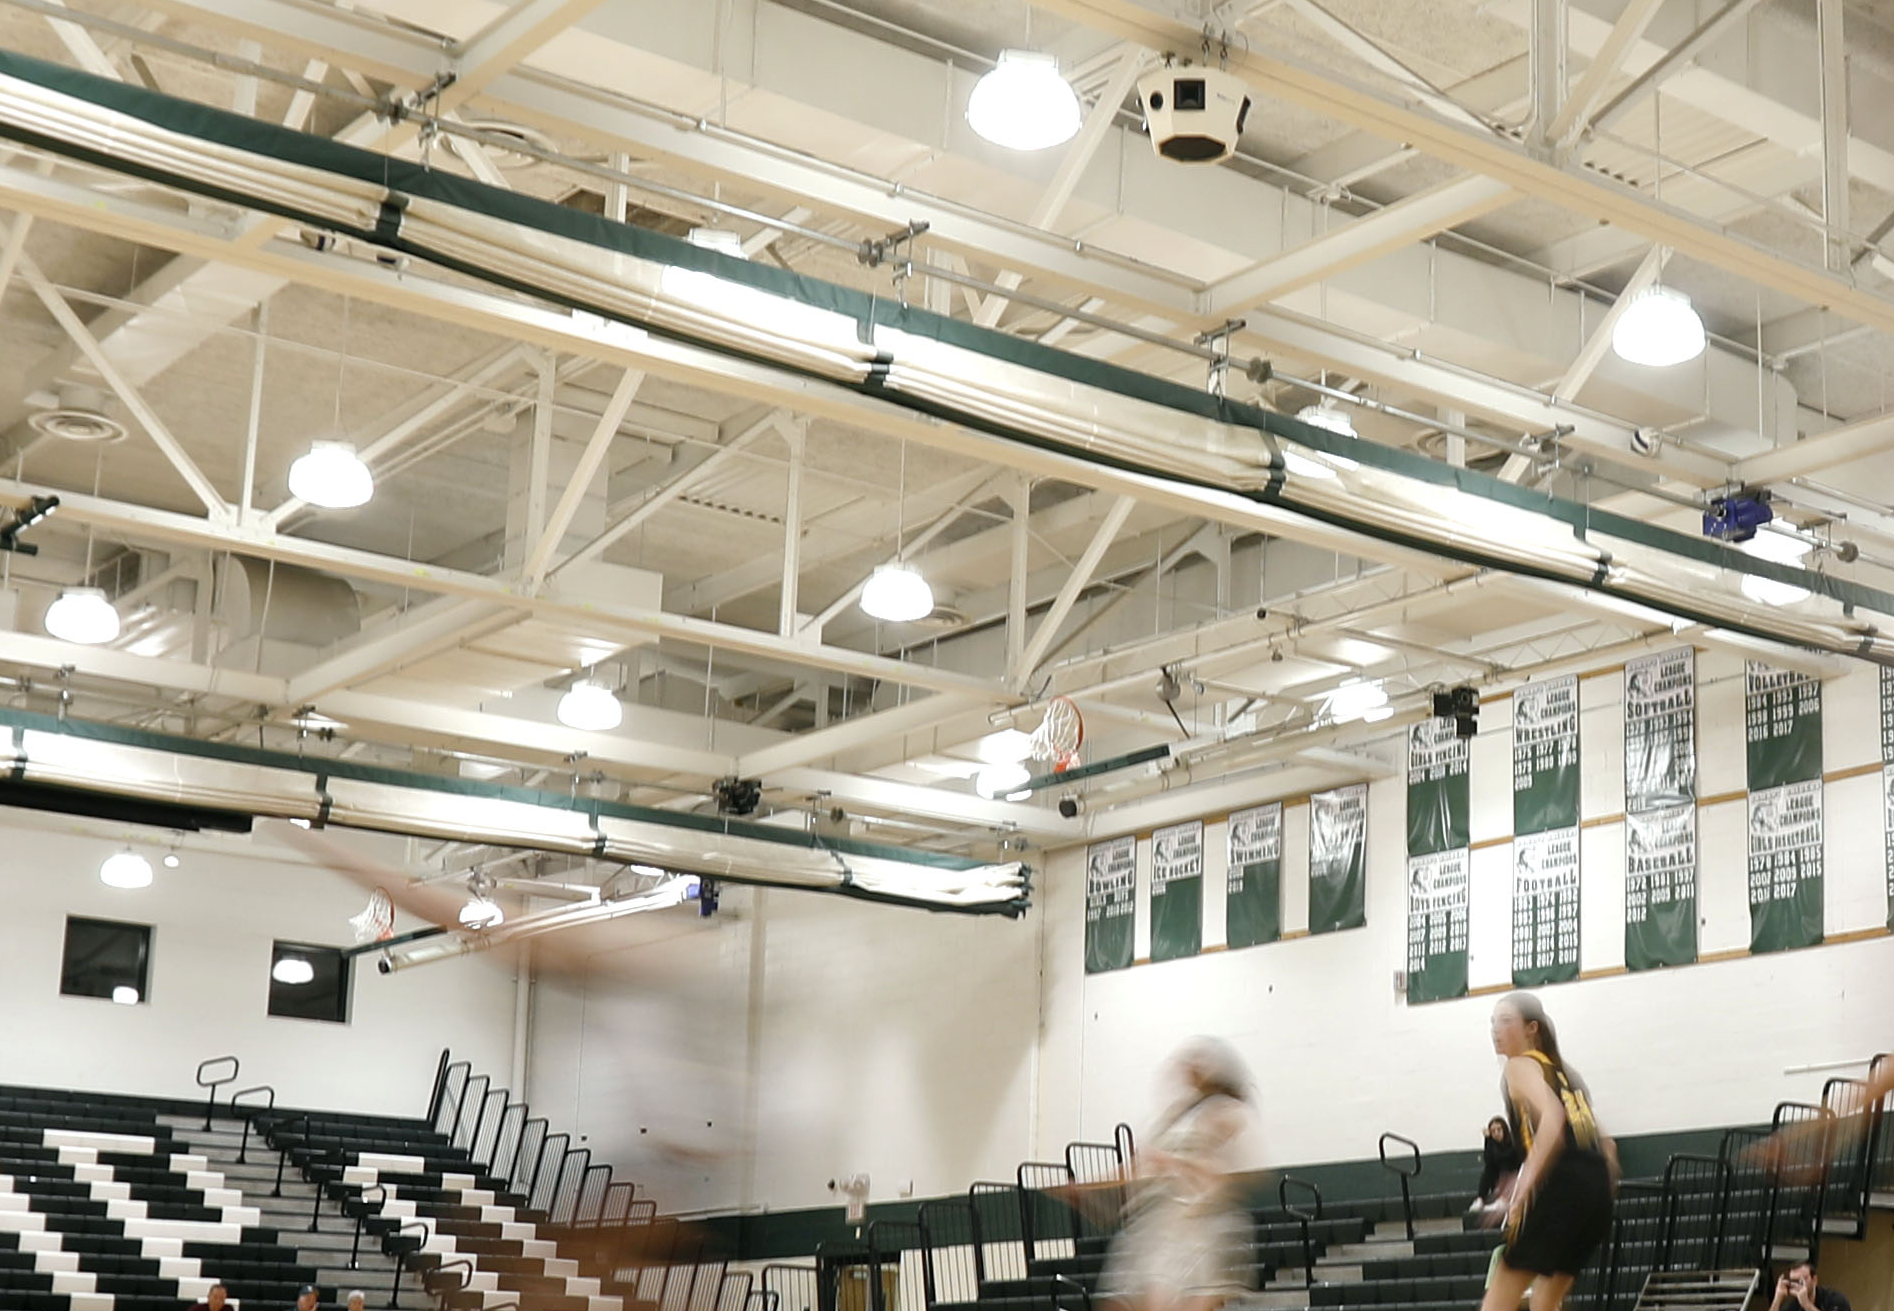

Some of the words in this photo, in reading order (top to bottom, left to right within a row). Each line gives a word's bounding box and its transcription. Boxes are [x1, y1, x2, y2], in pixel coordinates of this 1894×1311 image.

[1627, 690, 1691, 719] SOFTBALL
[1516, 714, 1575, 744] WRESTLING
[1230, 841, 1279, 865] SWIMMING
[1629, 846, 1693, 873] BASEBALL
[1089, 873, 1133, 894] BOWLING
[1154, 865, 1167, 880] ICE
[1517, 868, 1576, 893] FOOTBALL
